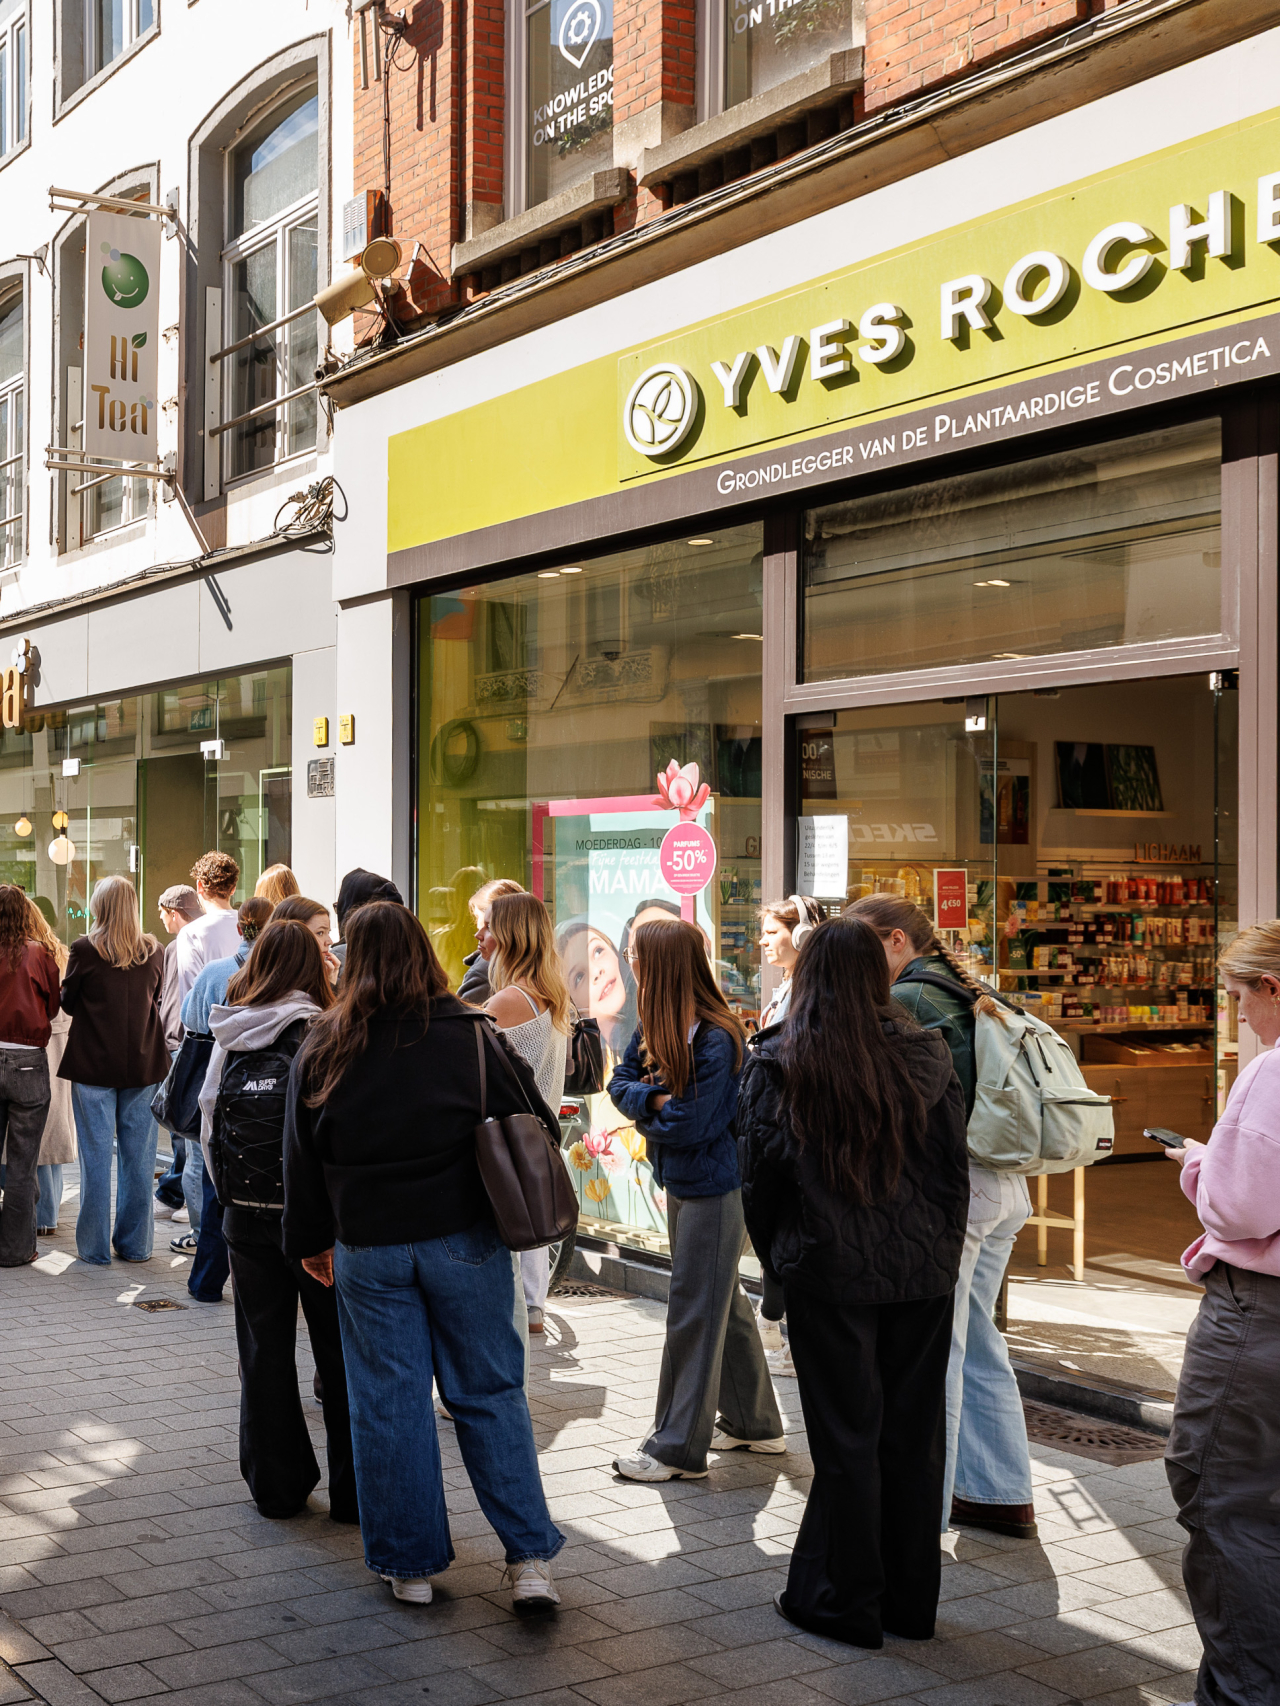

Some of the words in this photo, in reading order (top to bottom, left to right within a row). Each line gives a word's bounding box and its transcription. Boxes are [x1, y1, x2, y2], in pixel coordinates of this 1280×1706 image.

[533, 121, 555, 146] ON
[557, 103, 587, 133] THE
[710, 302, 906, 408] YVES
[940, 170, 1280, 341] ROCHE
[110, 331, 147, 382] Hi
[91, 384, 148, 435] Tea
[576, 838, 641, 850] MOEDERDAG
[673, 840, 701, 848] PARFUMS
[1135, 843, 1202, 863] LICHAAM
